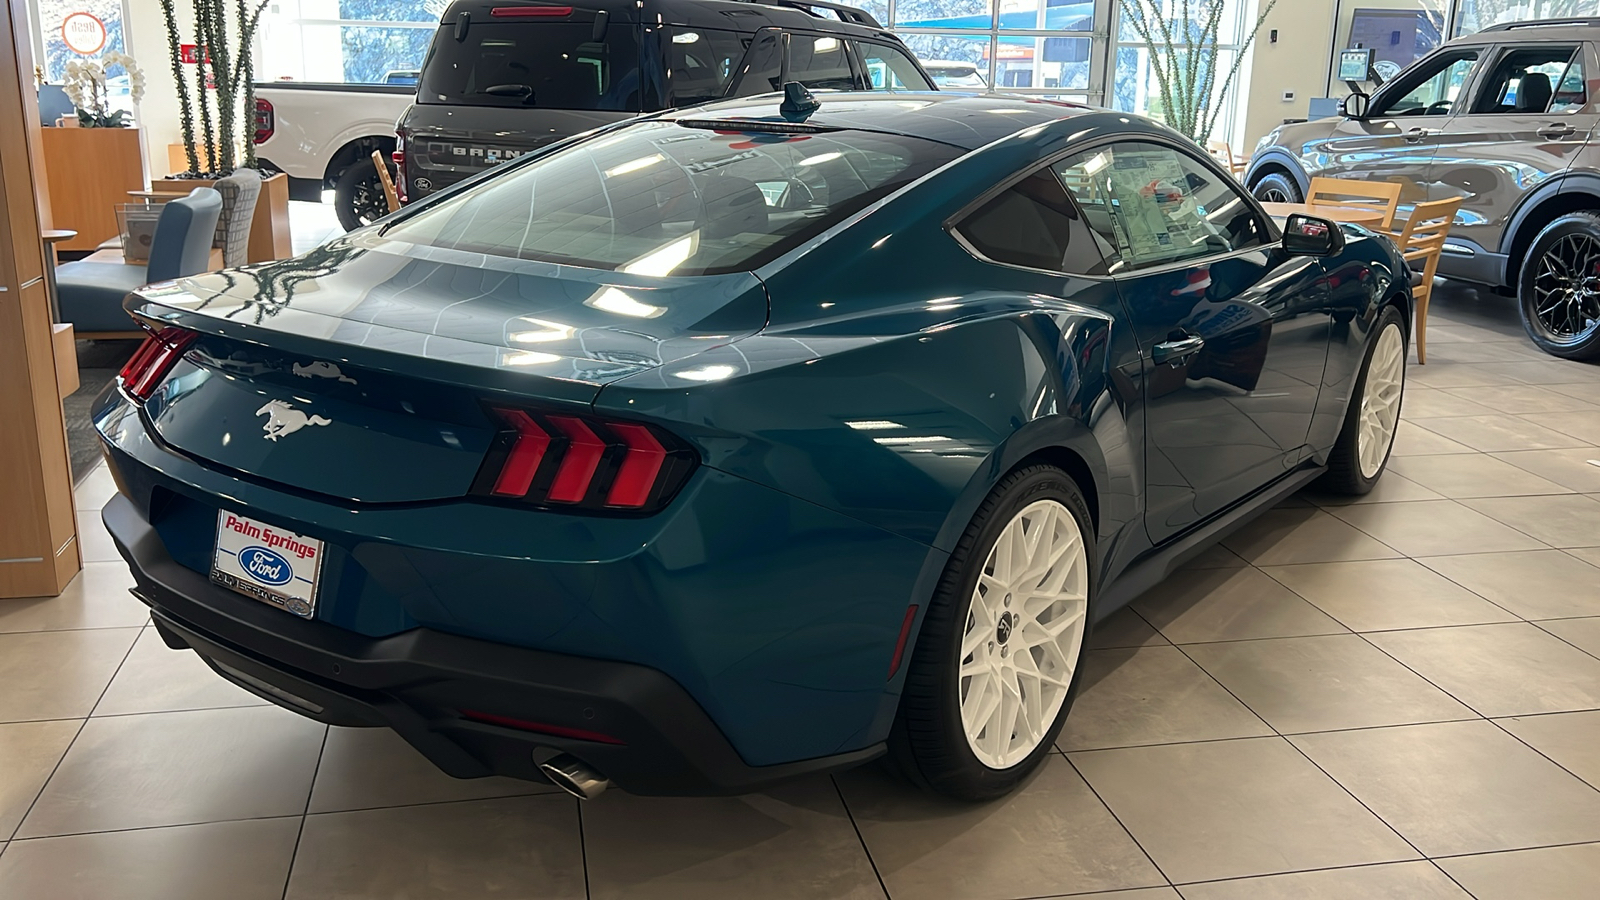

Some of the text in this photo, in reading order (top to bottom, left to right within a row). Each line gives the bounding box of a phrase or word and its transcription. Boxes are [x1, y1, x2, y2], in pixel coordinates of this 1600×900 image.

[453, 147, 531, 158] BRON
[225, 515, 316, 559] Palm Springs
[249, 551, 282, 580] Ford
